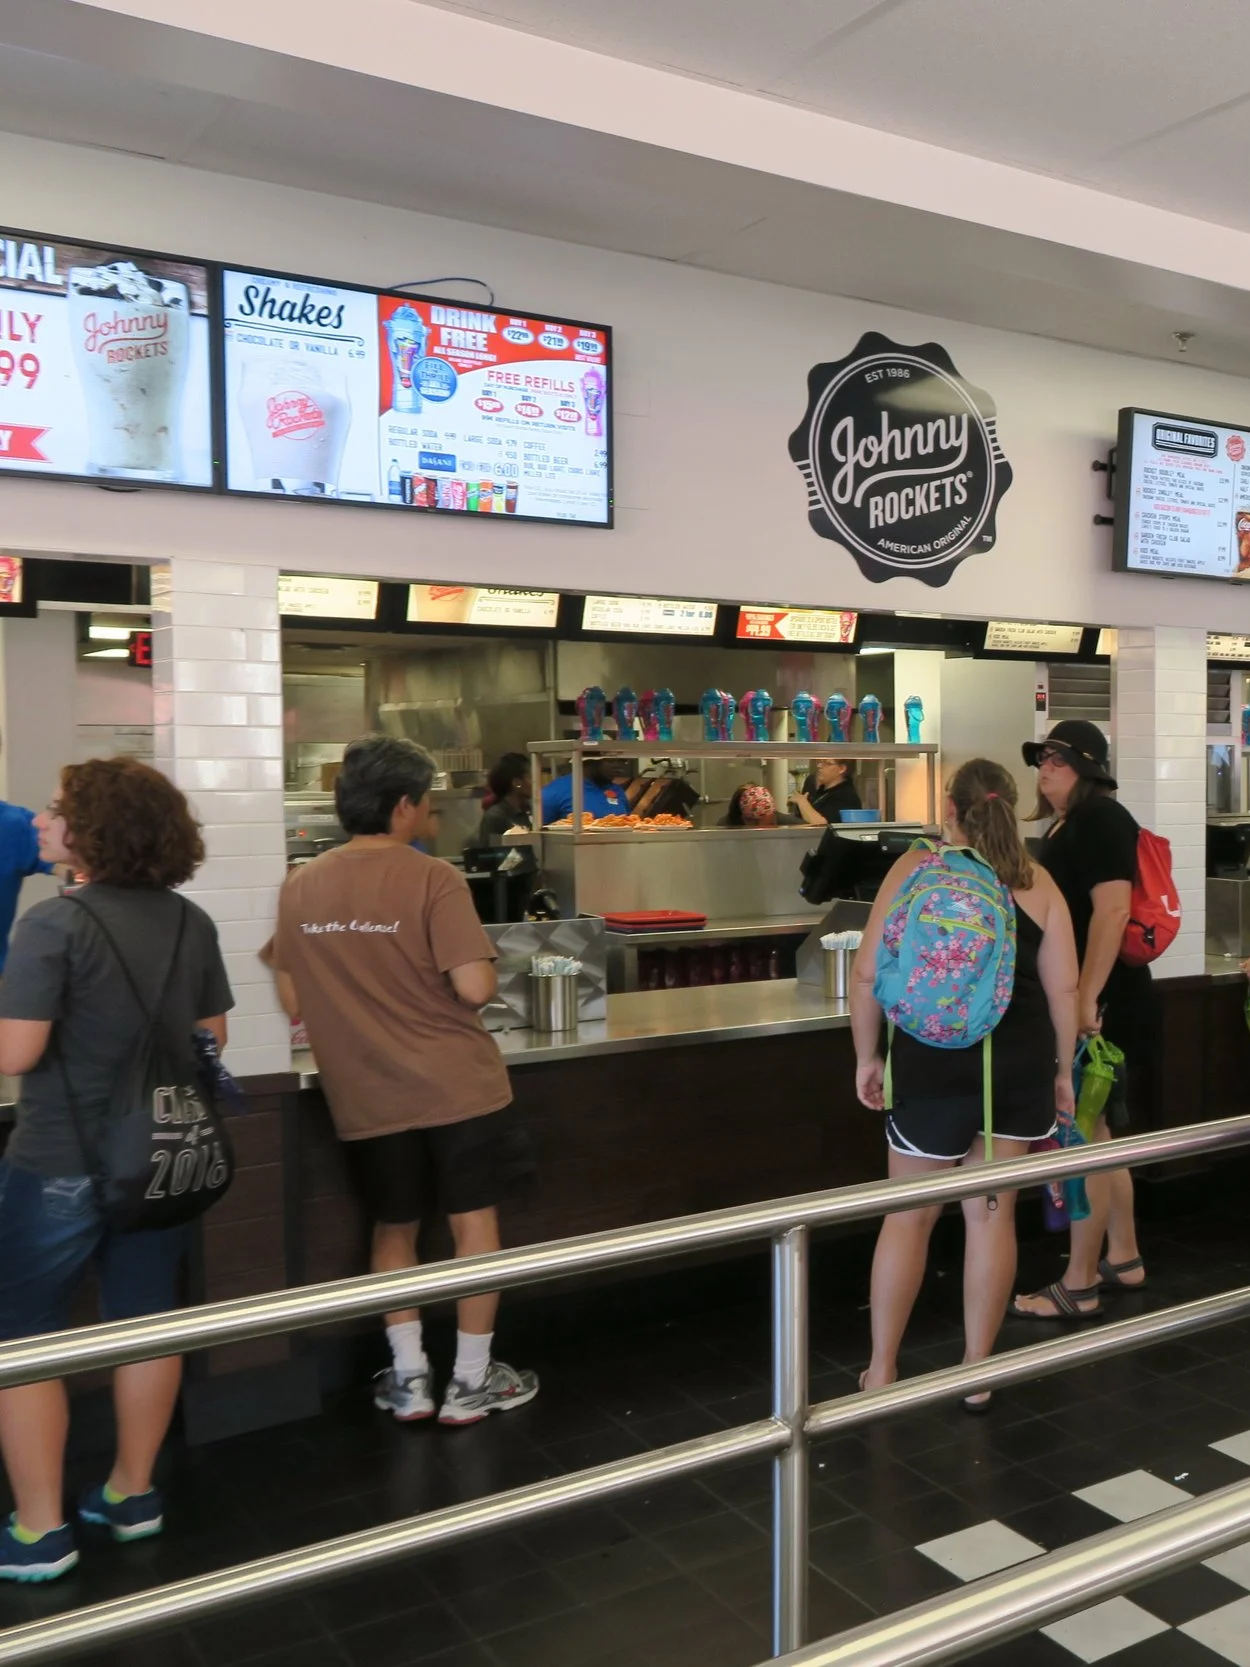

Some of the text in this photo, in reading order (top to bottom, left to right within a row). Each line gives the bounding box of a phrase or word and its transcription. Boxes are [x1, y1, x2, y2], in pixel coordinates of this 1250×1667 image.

[238, 285, 345, 329] Shakes
[430, 306, 497, 333] DRINK
[83, 311, 169, 352] Johnny
[440, 327, 489, 351] FREE
[107, 341, 168, 364] ROCKETS
[237, 334, 284, 349] CHOCOLATE
[289, 341, 300, 350] OR
[304, 343, 338, 356] VANILLA
[487, 370, 576, 393] FREE REFILLS
[864, 368, 911, 383] EST 1986
[523, 441, 546, 451] COFFEE
[421, 457, 453, 467] DASANI
[831, 411, 968, 507] Johnny
[877, 514, 972, 554] AMERICAN ORIGINAL
[325, 921, 347, 932] the
[144, 1142, 228, 1199] 2016
